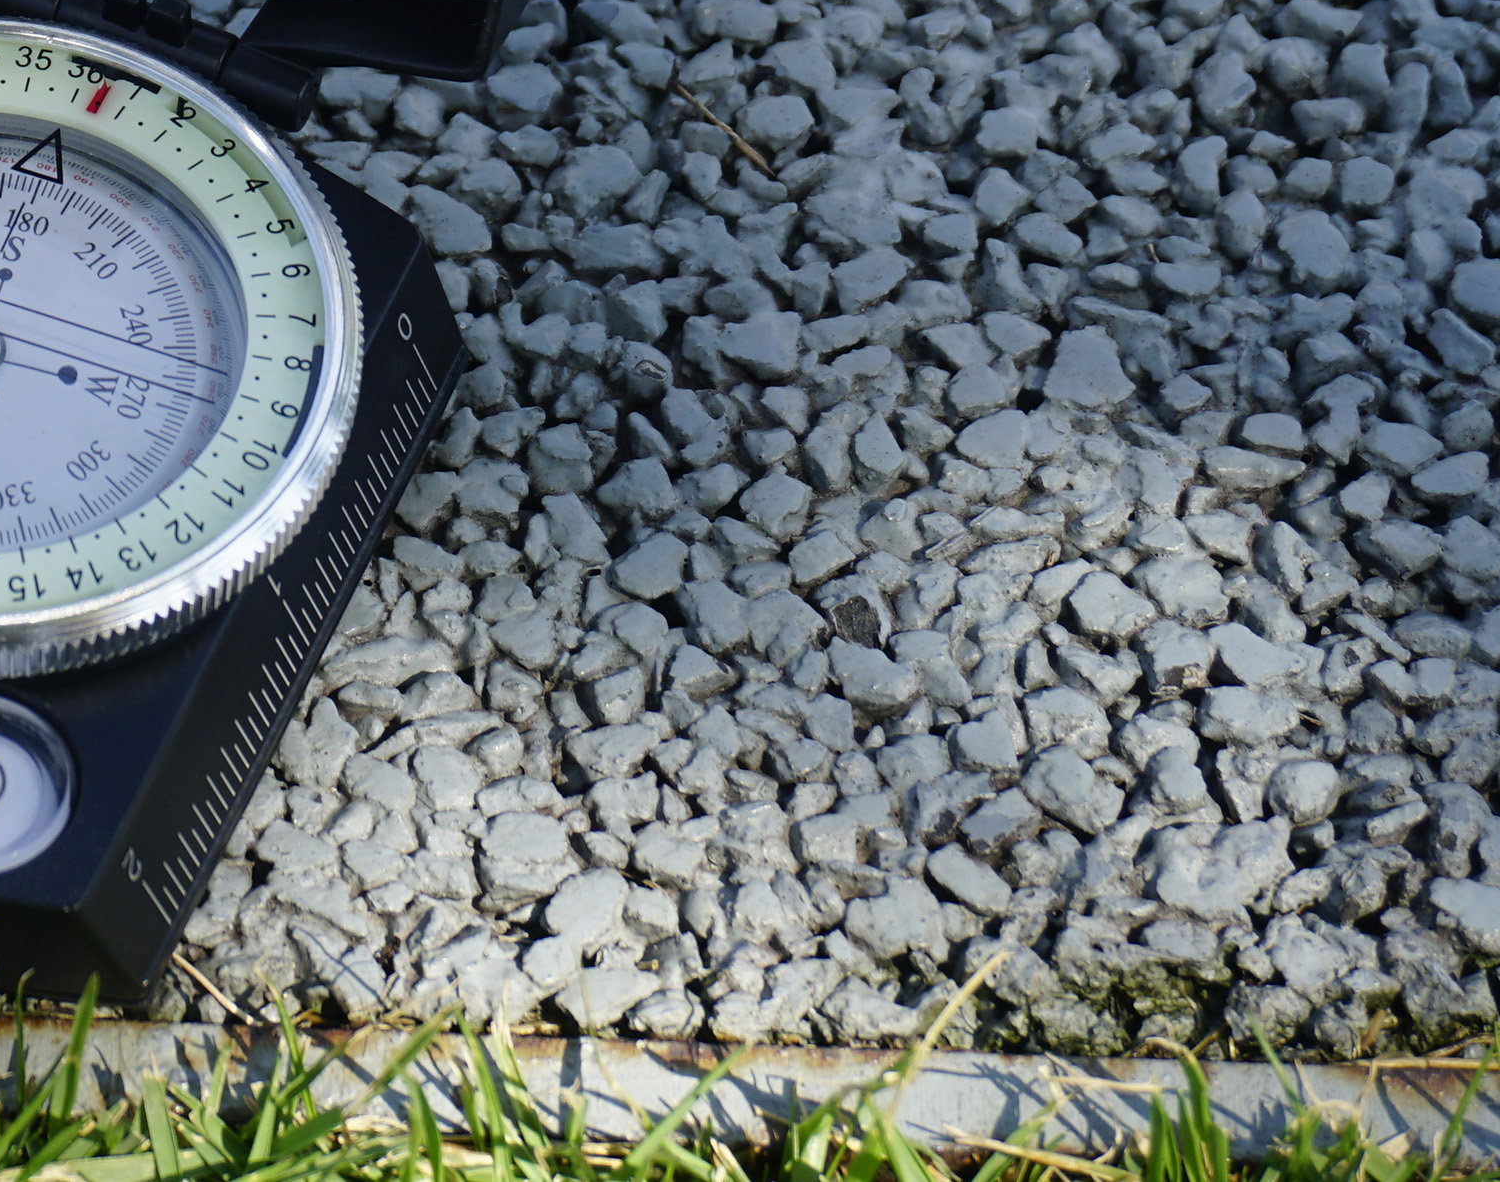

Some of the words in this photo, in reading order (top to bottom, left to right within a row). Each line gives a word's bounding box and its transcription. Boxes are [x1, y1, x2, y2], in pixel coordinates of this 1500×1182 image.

[14, 45, 53, 71] 35
[67, 62, 105, 85] 36
[169, 106, 197, 129] 2
[210, 138, 236, 157] 3
[245, 178, 270, 195] 4
[3, 207, 50, 237] 180
[266, 218, 295, 235] 5
[2, 235, 26, 263] S
[72, 241, 119, 281] 210
[282, 263, 311, 279] 6
[120, 303, 155, 346] 240
[288, 313, 317, 328] 7
[397, 311, 414, 343] 0
[284, 355, 313, 372] 8
[84, 373, 121, 407] W
[116, 374, 151, 420] 270
[270, 401, 299, 419] 9
[66, 439, 112, 482] 300
[242, 438, 279, 472] 10
[211, 477, 245, 509] 11
[164, 512, 206, 546] 12
[117, 540, 158, 572] 13
[8, 573, 47, 603] 15
[65, 560, 104, 591] 14
[266, 573, 283, 597] 1
[121, 846, 144, 885] 2
